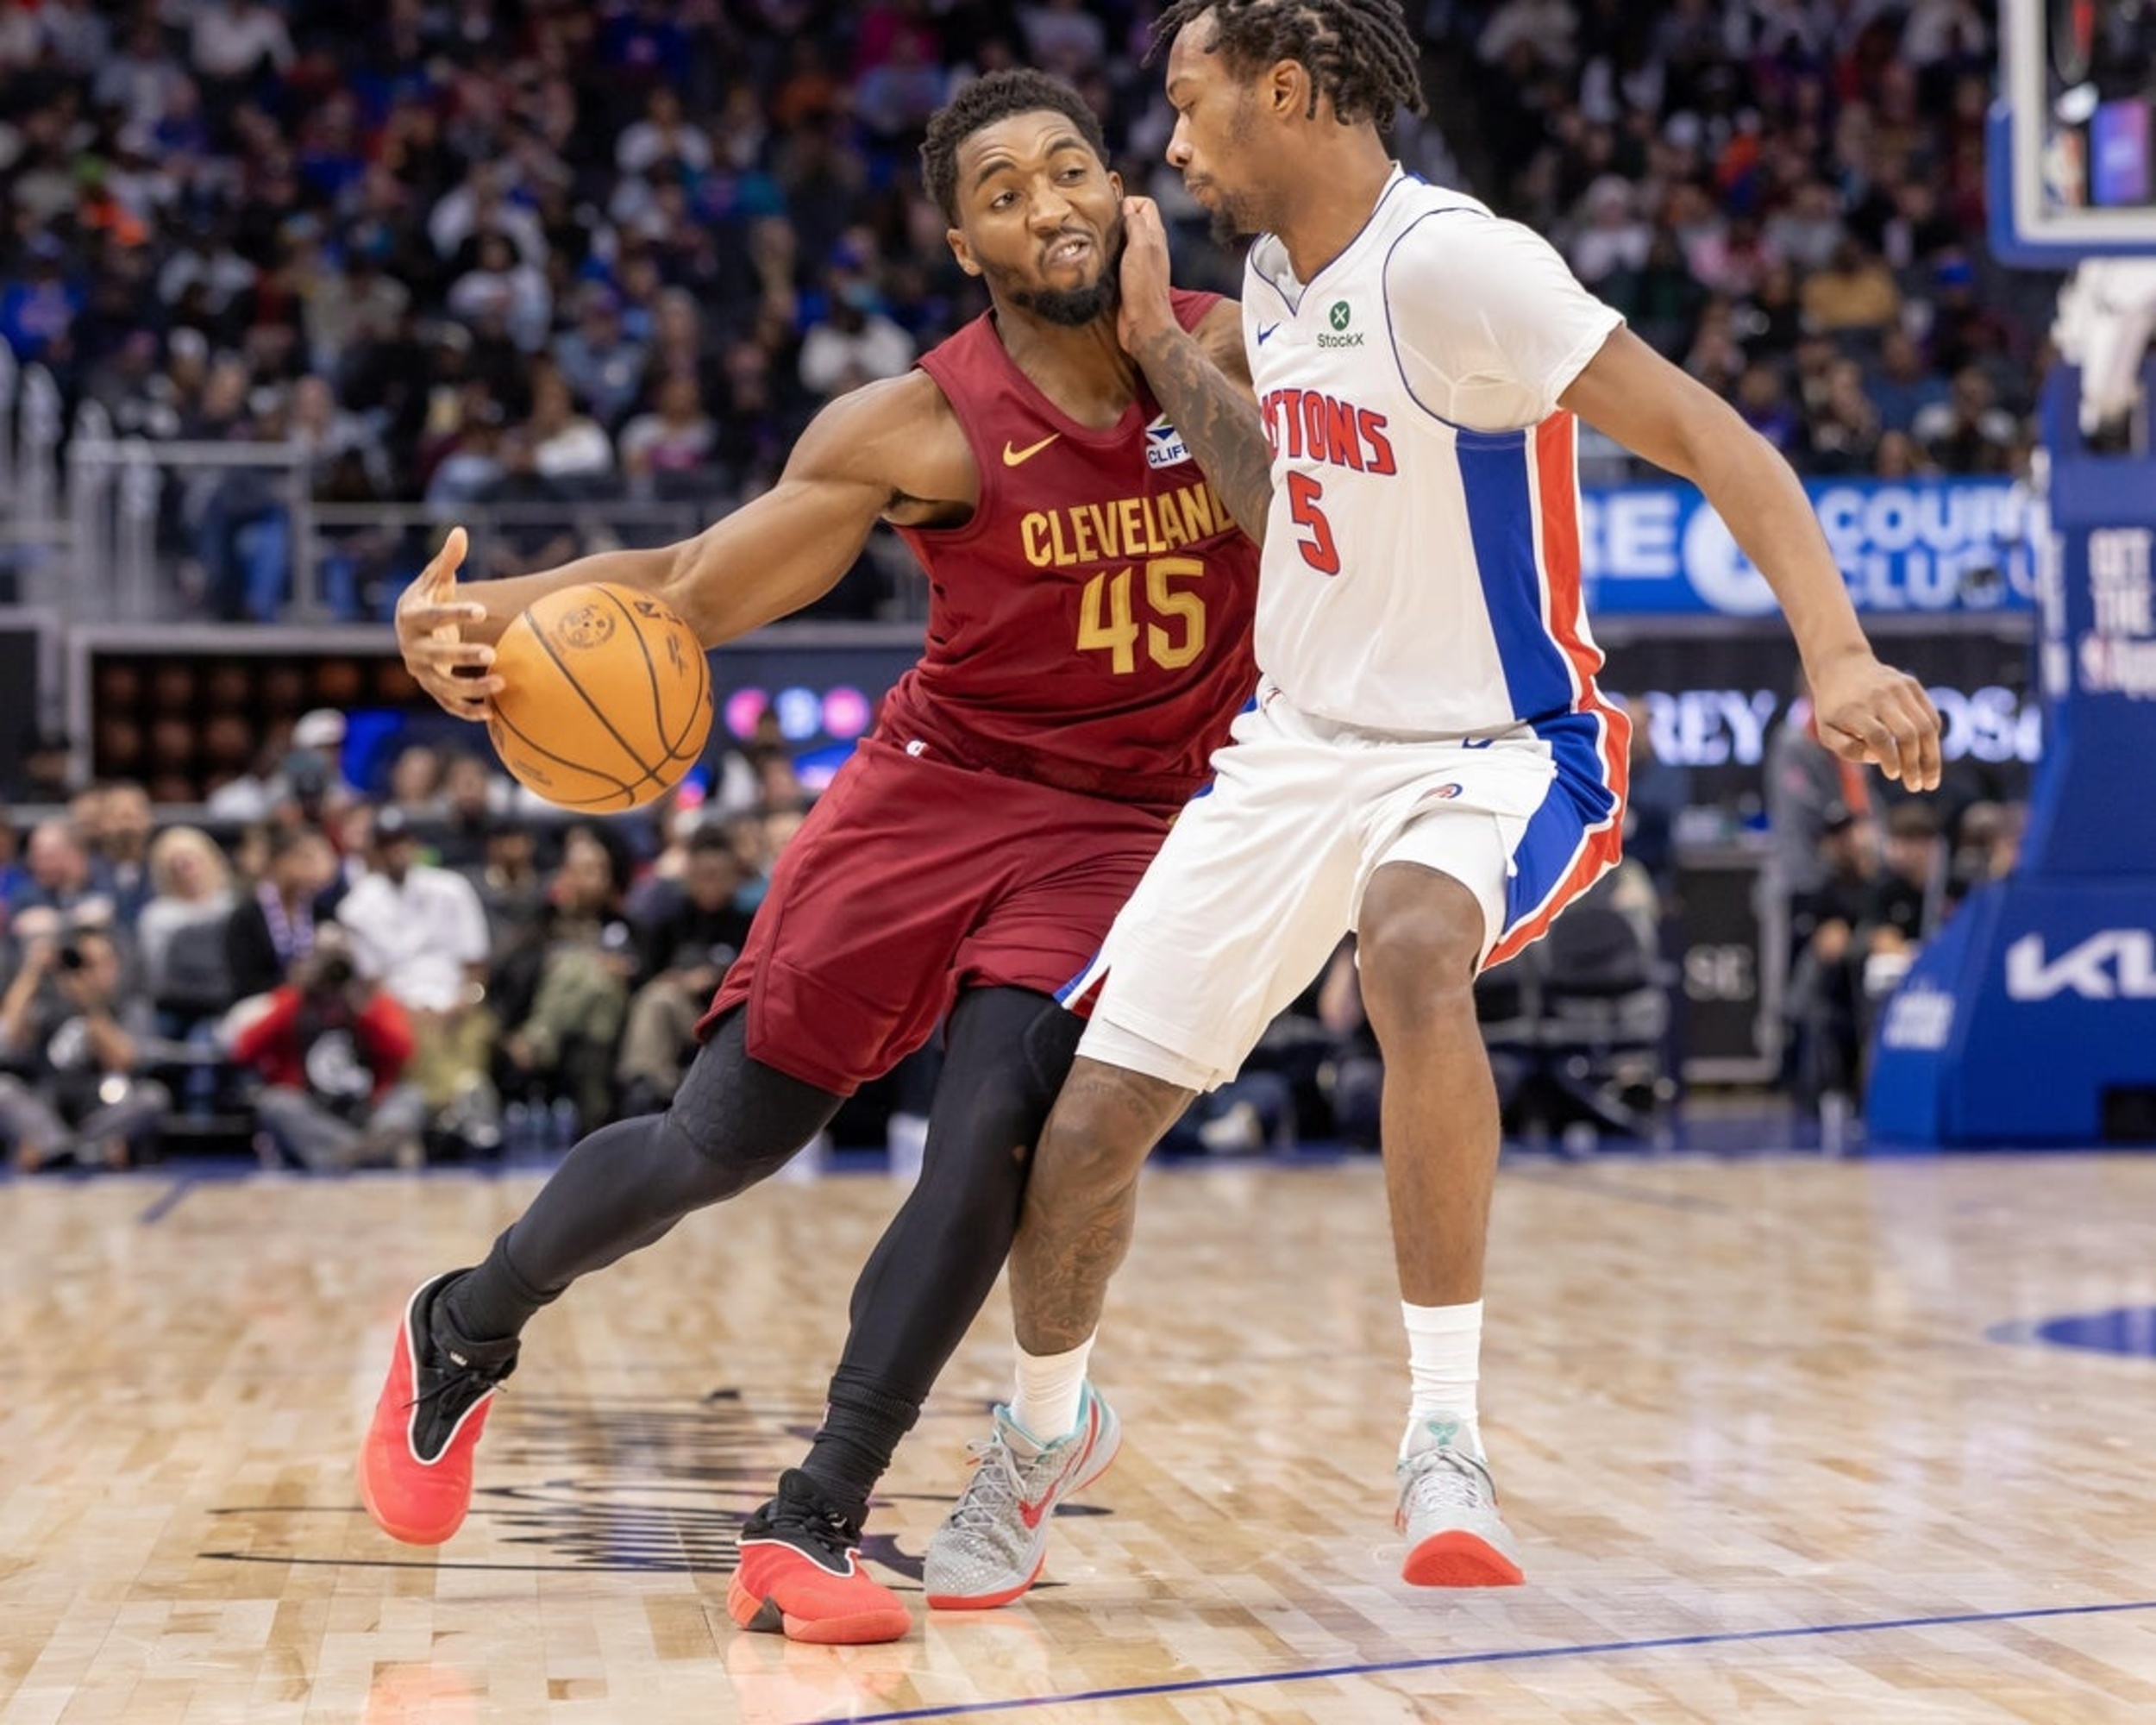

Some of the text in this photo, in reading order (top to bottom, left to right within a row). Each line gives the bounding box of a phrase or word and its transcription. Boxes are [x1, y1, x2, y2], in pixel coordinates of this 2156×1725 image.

[1317, 332, 1364, 348] StockX
[1288, 470, 1340, 576] 5
[1076, 557, 1206, 674] 45
